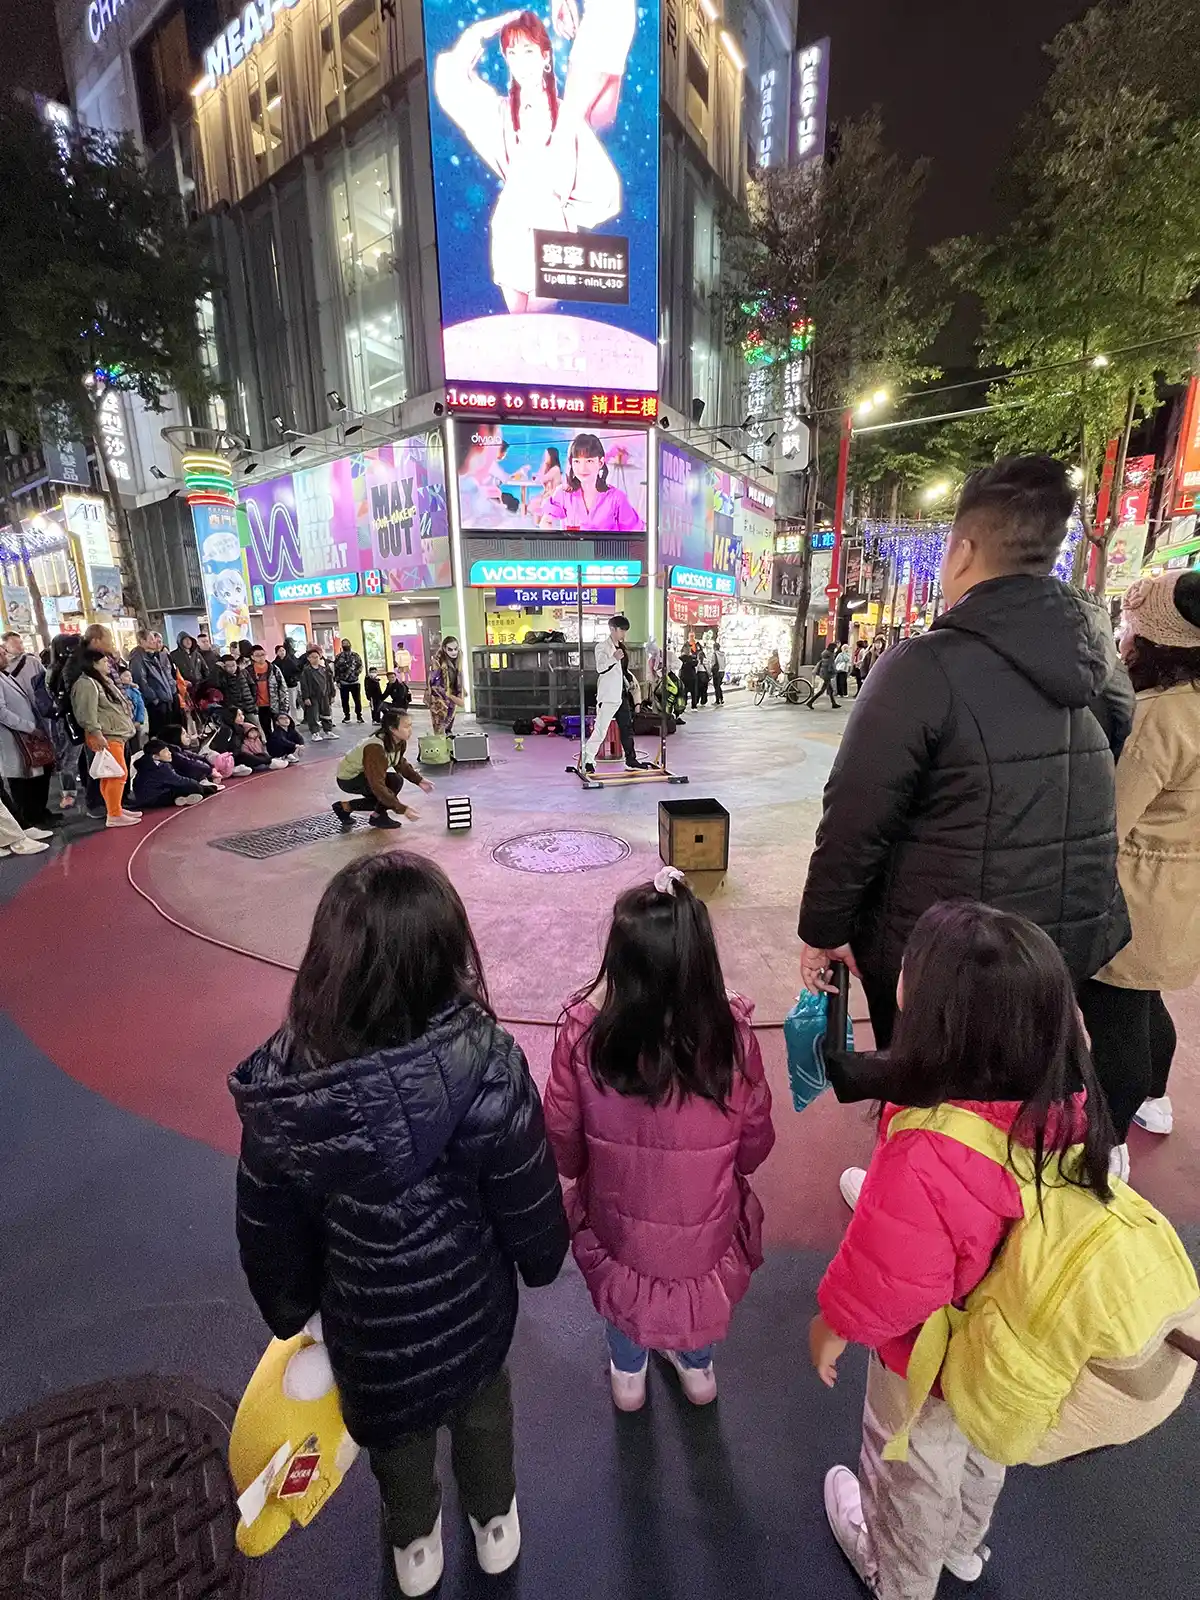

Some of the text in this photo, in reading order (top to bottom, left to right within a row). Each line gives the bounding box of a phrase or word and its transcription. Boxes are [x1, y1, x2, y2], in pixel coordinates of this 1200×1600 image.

[589, 251, 623, 270] Nini
[446, 389, 657, 416] lcome to Taiwan 請上三樓
[371, 477, 414, 521] MAX
[378, 517, 413, 559] OUT
[482, 565, 574, 581] watsons
[676, 572, 713, 589] watsons
[278, 582, 322, 598] watsons
[514, 589, 538, 601] Tax
[542, 589, 590, 601] Refund
